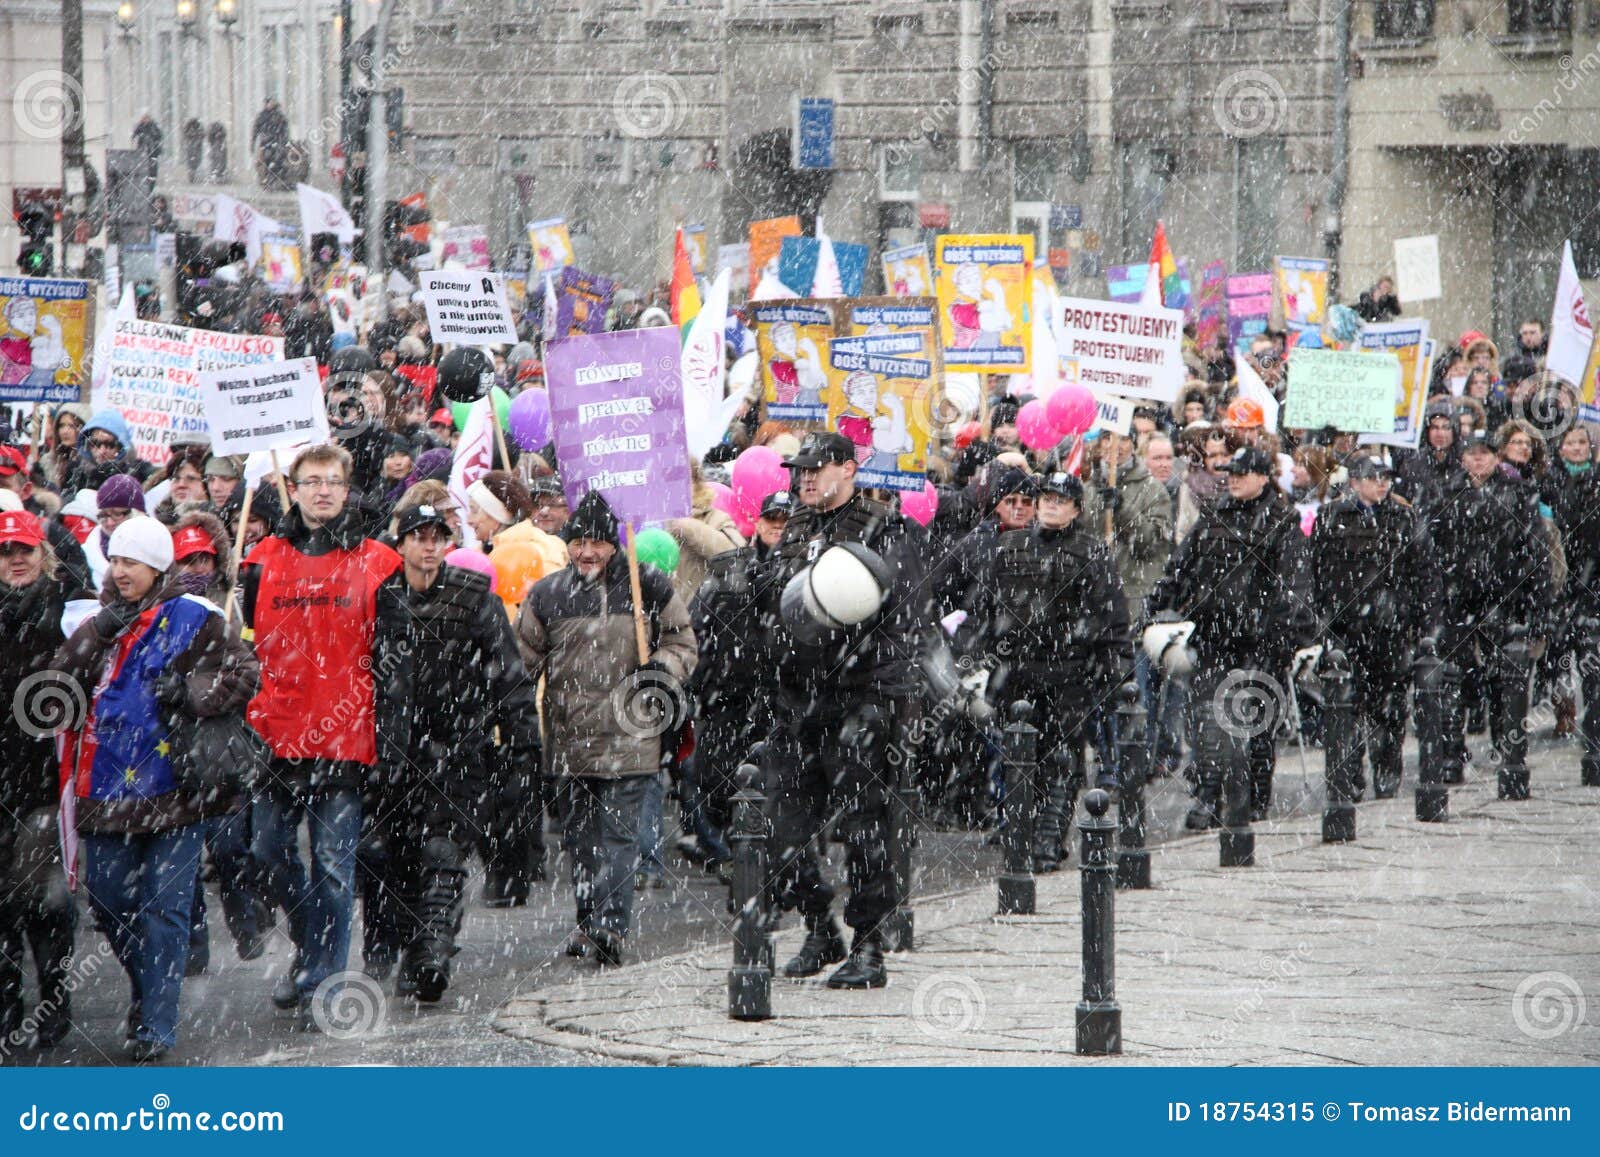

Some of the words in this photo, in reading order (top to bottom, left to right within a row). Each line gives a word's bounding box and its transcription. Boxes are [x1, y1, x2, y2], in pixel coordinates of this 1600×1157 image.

[429, 280, 472, 293] Chcemy
[439, 311, 447, 320] a
[1064, 308, 1177, 340] PROTESTUJEMY!
[1073, 339, 1165, 365] PROTESTUJEMY!
[579, 361, 640, 382] równe
[868, 357, 929, 377] WYZYSKU!
[1081, 369, 1153, 389] PROTESTUJEMY!
[586, 435, 648, 455] równe
